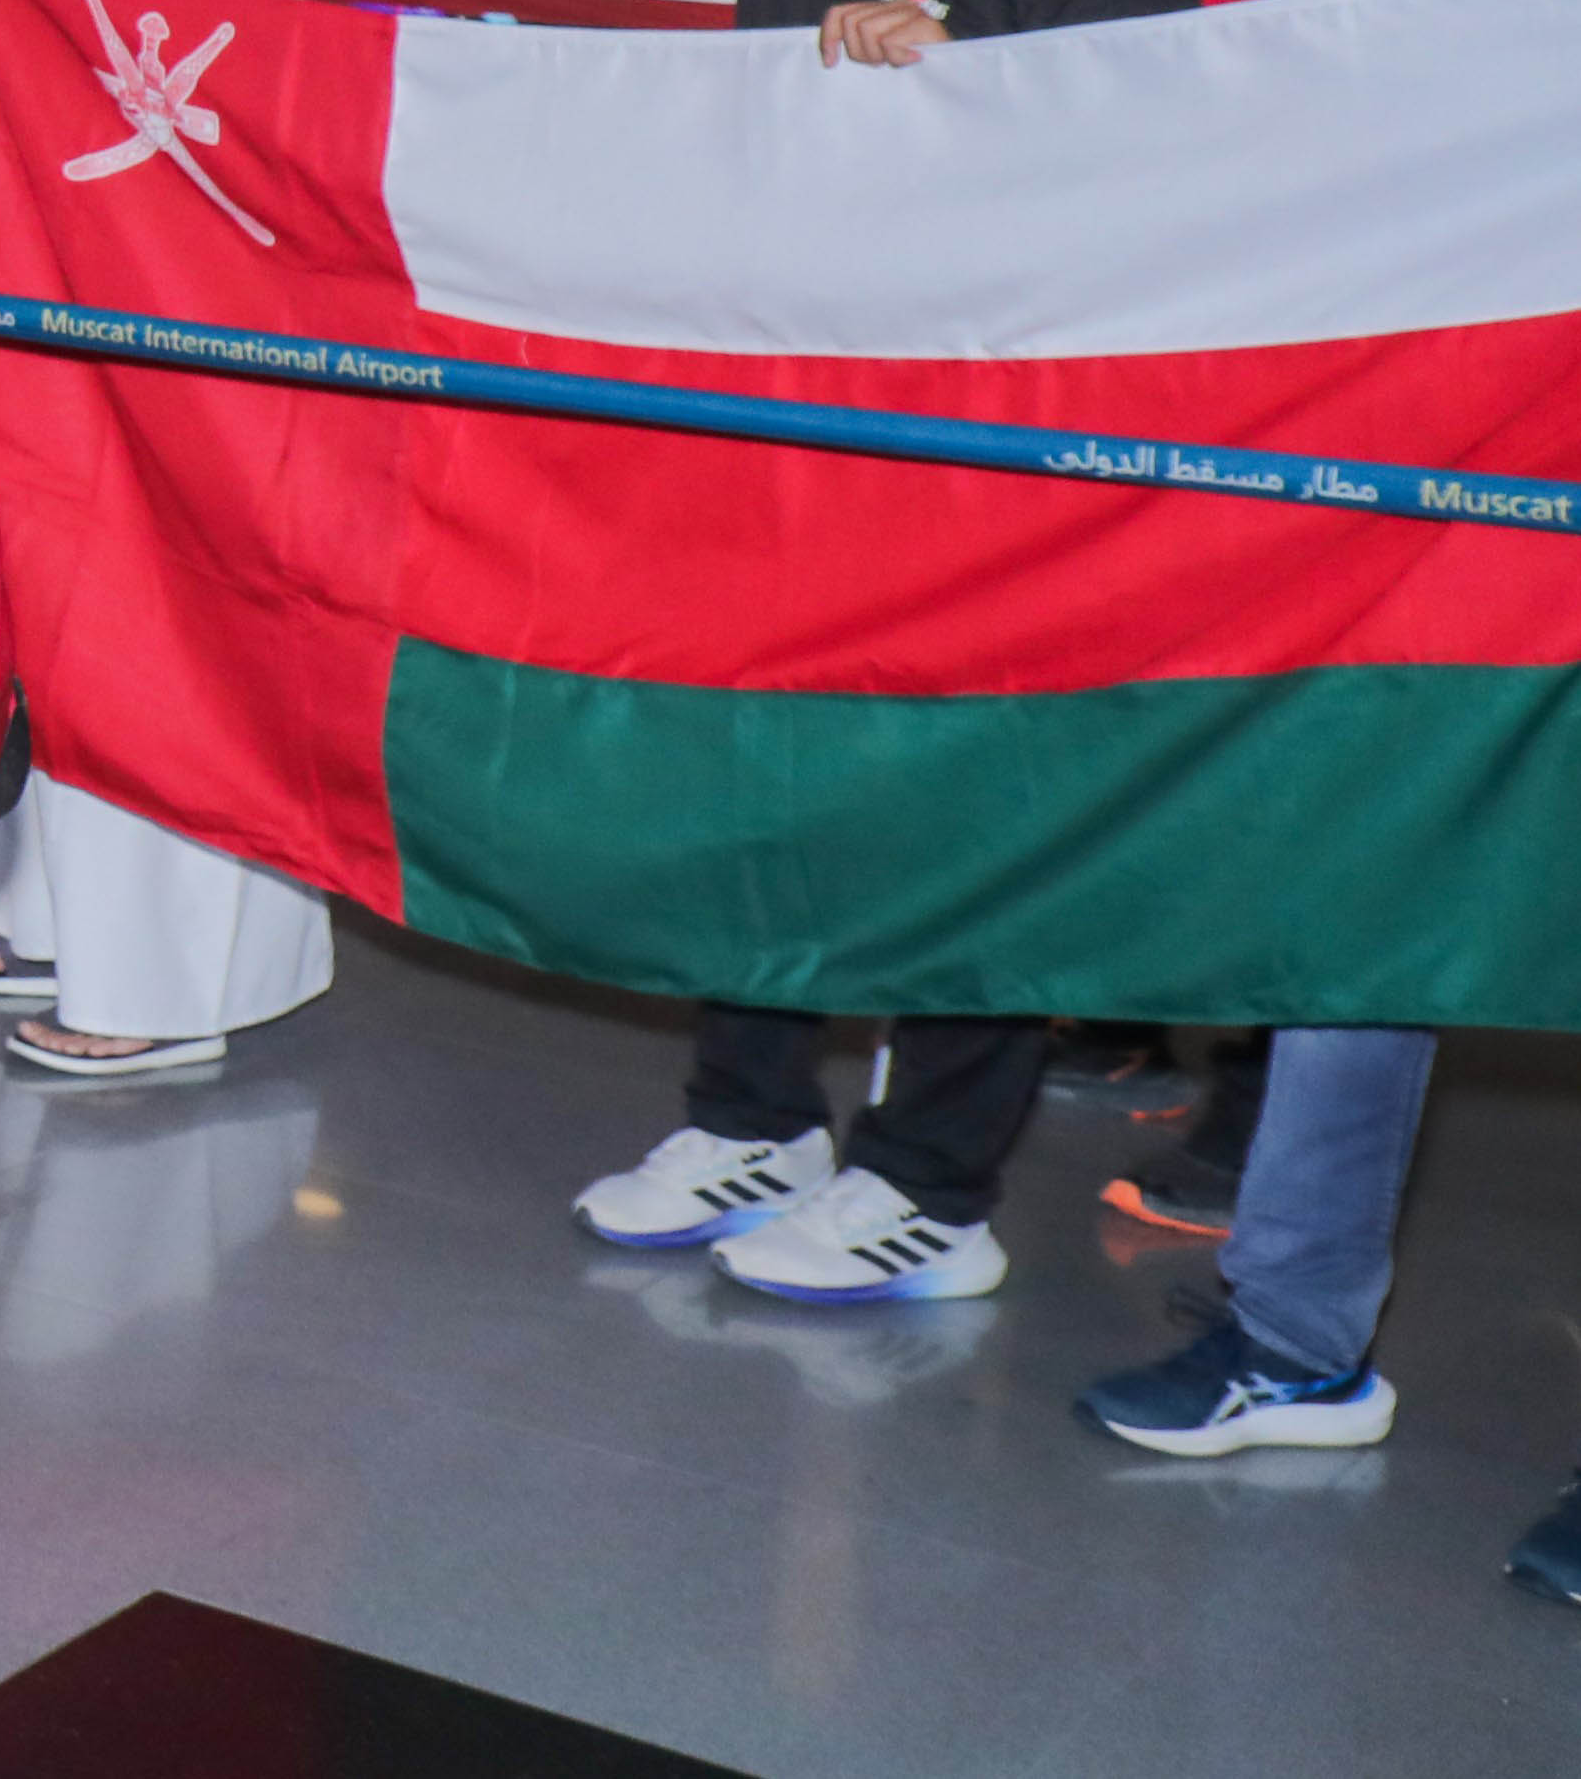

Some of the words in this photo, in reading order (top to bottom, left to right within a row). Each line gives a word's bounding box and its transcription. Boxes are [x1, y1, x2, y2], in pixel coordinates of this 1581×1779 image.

[42, 308, 136, 349] Muscat
[144, 322, 328, 375] International
[336, 348, 444, 391] Airport
[1299, 464, 1380, 503] مطار
[1419, 477, 1573, 525] Muscat
